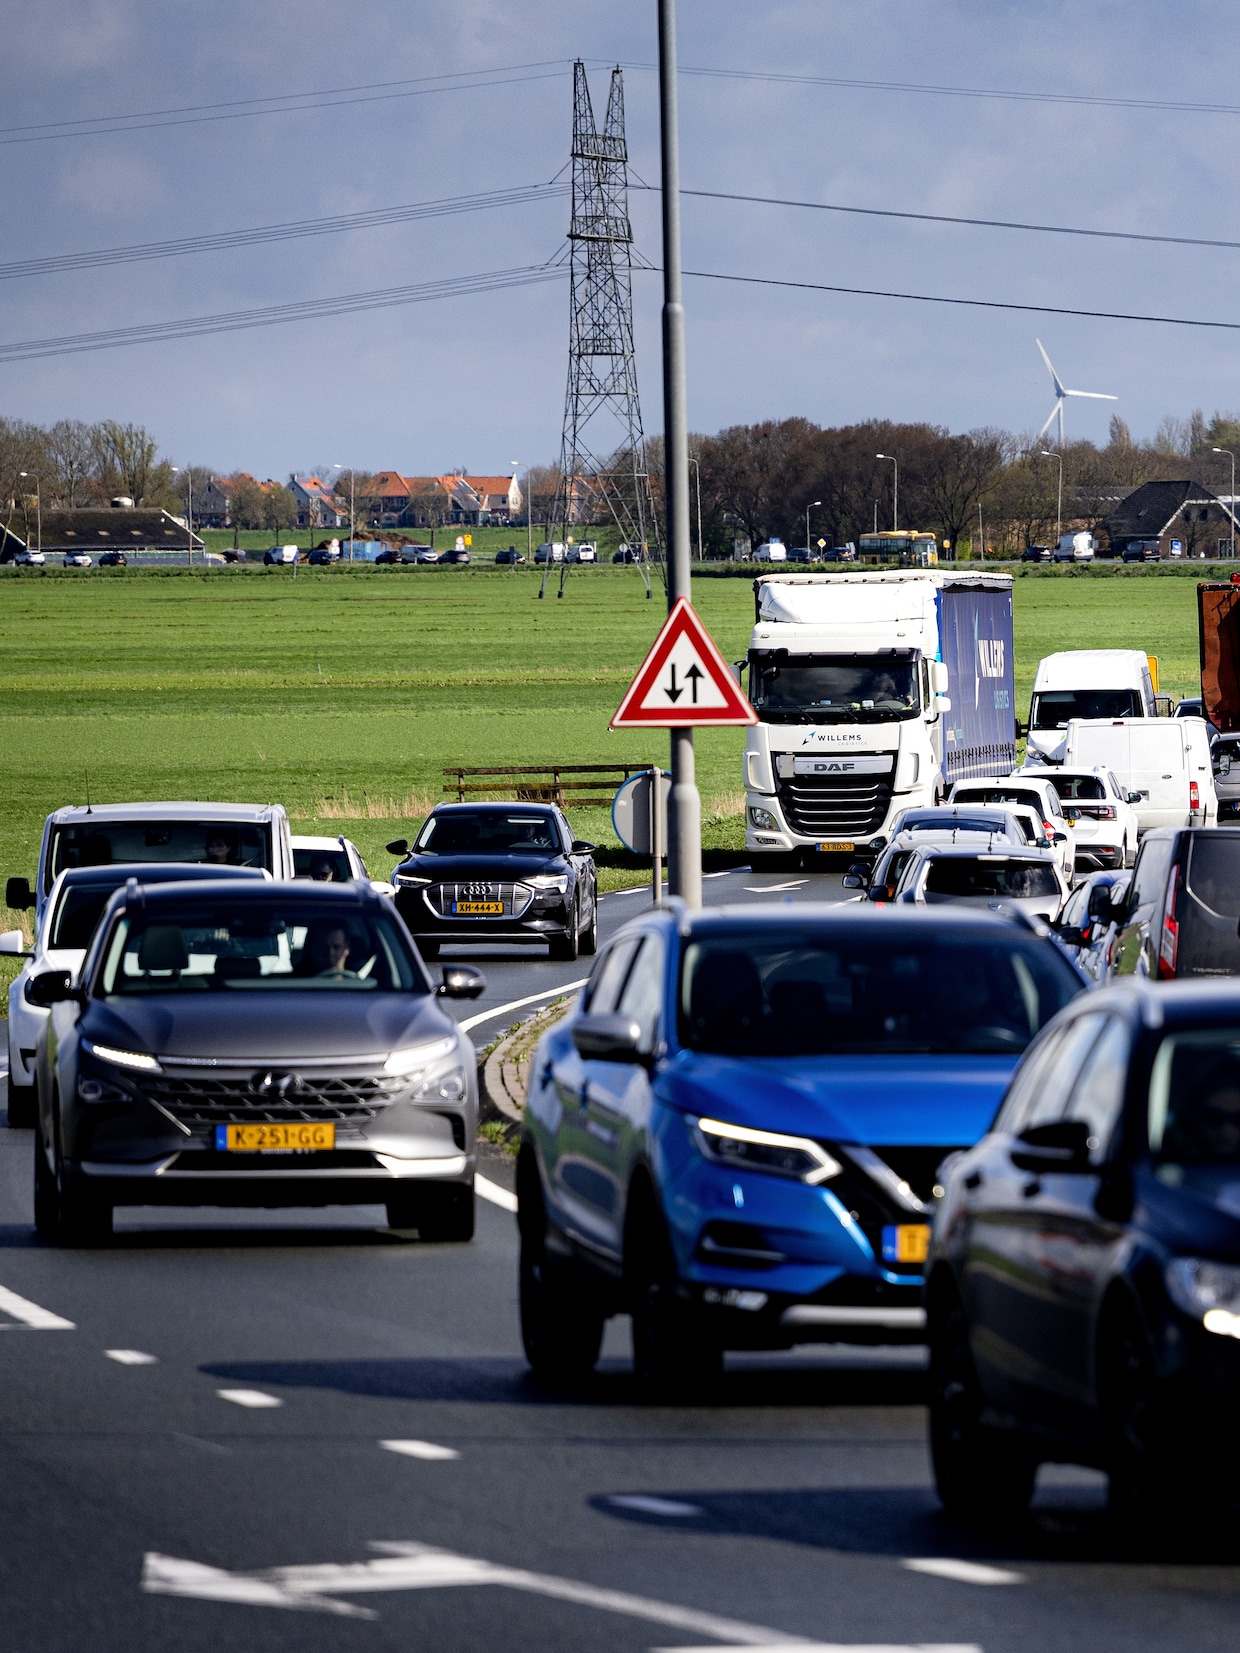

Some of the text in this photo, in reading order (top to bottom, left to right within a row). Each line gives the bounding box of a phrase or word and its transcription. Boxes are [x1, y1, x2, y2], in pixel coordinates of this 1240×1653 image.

[814, 763, 855, 772] DAF
[459, 903, 500, 912] XH-444-X
[235, 1126, 325, 1145] K-251-GG
